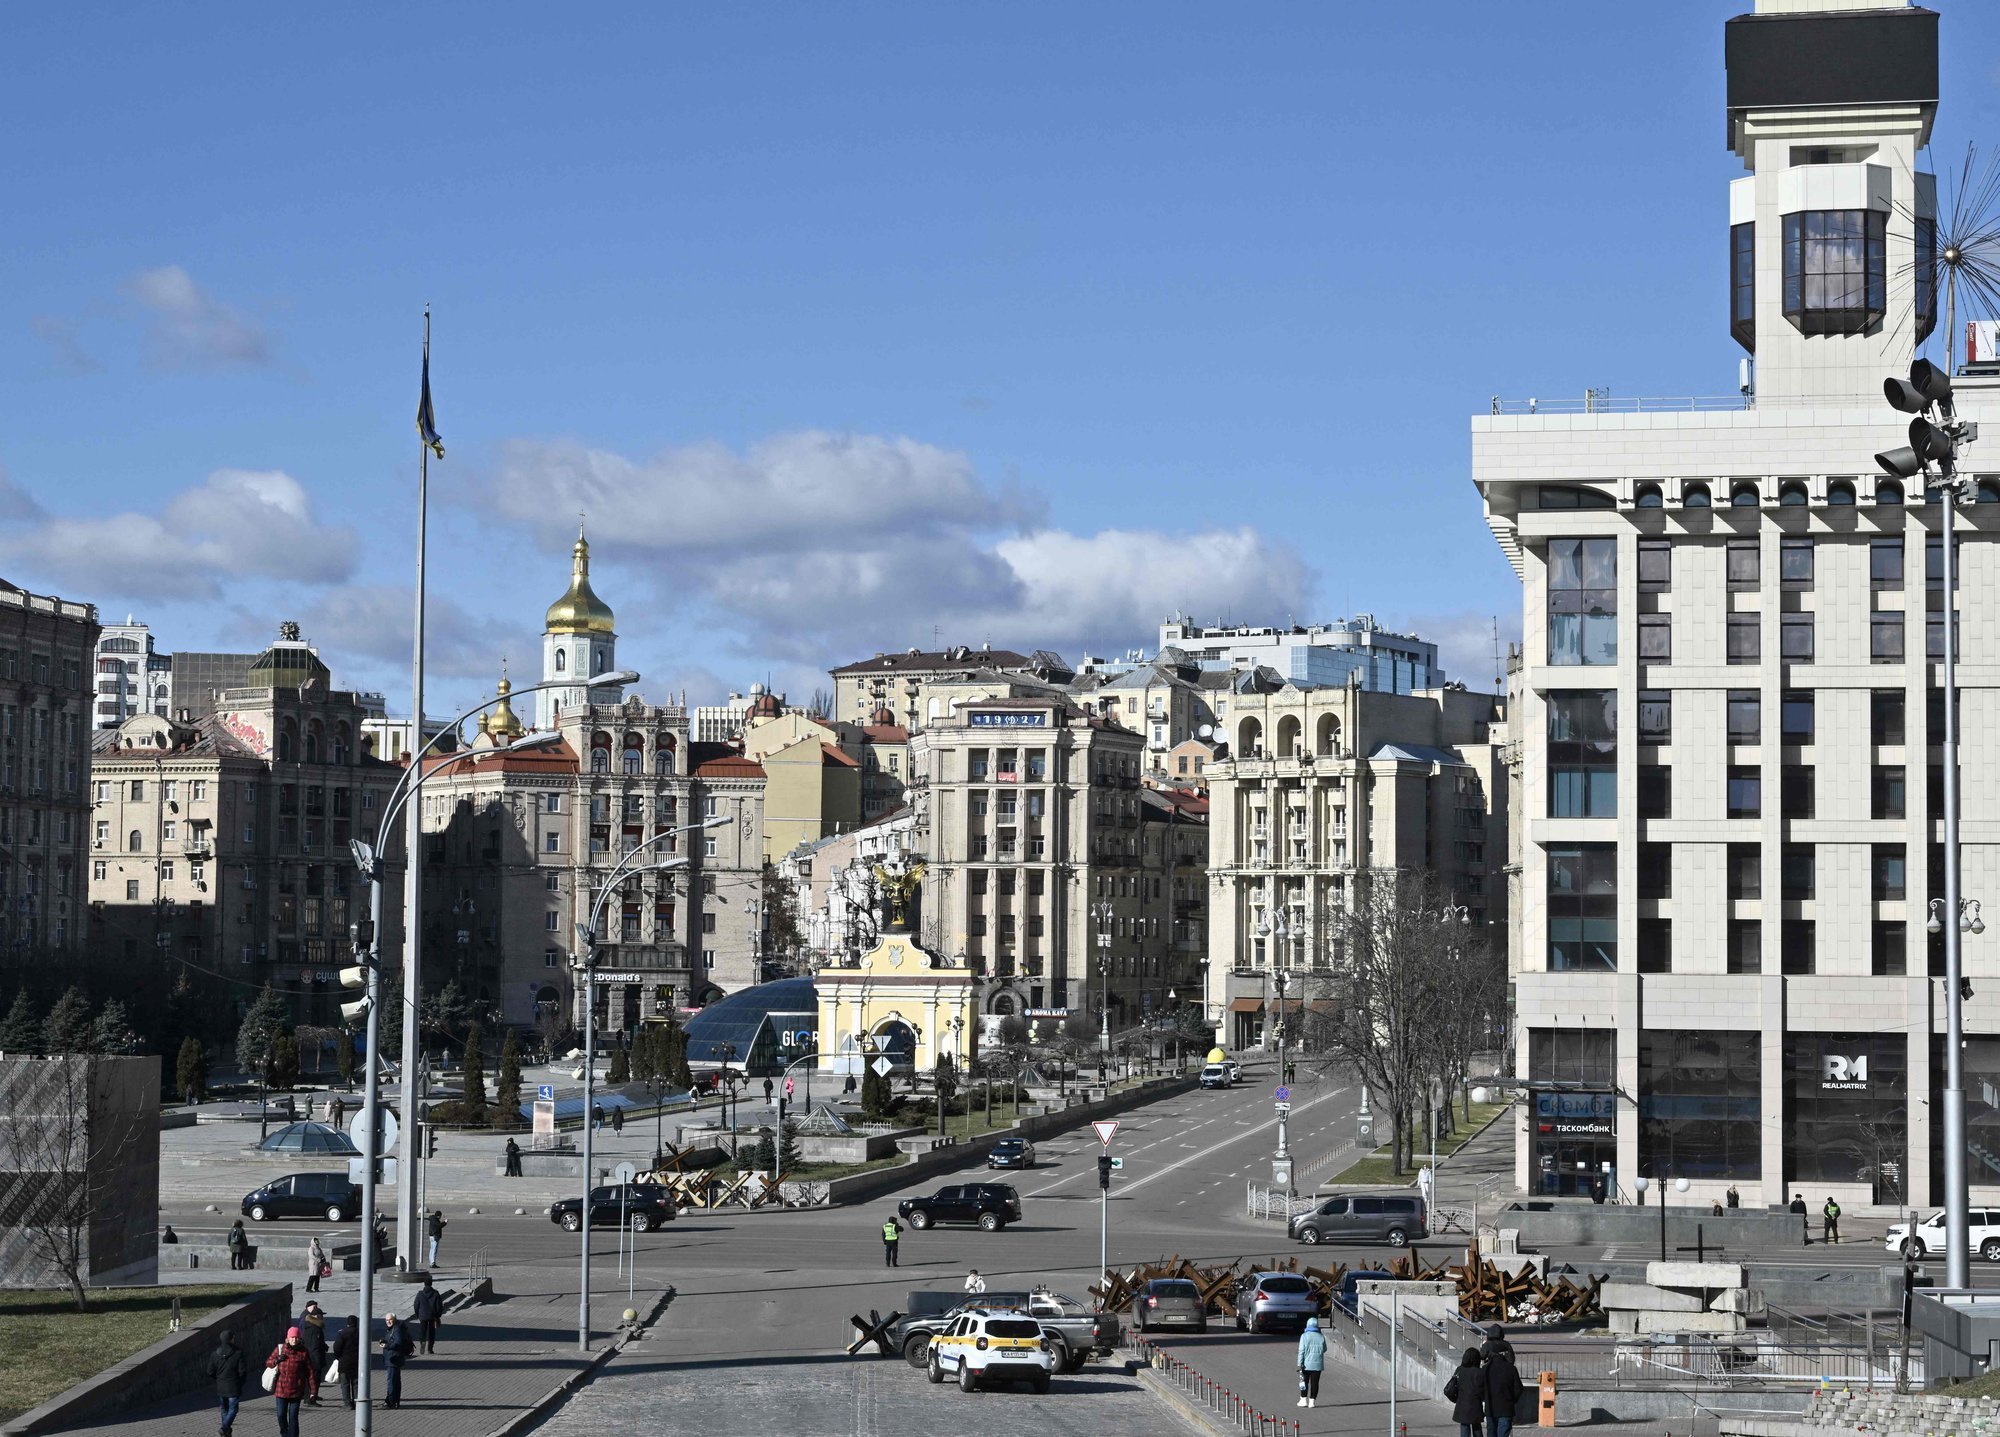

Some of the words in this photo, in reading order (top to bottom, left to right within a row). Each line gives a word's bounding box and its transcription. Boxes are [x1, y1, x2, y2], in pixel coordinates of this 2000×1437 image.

[1823, 1055, 1867, 1081] RM
[1822, 1082, 1867, 1090] REALMATRIX
[1557, 1124, 1610, 1132] таскомбанк
